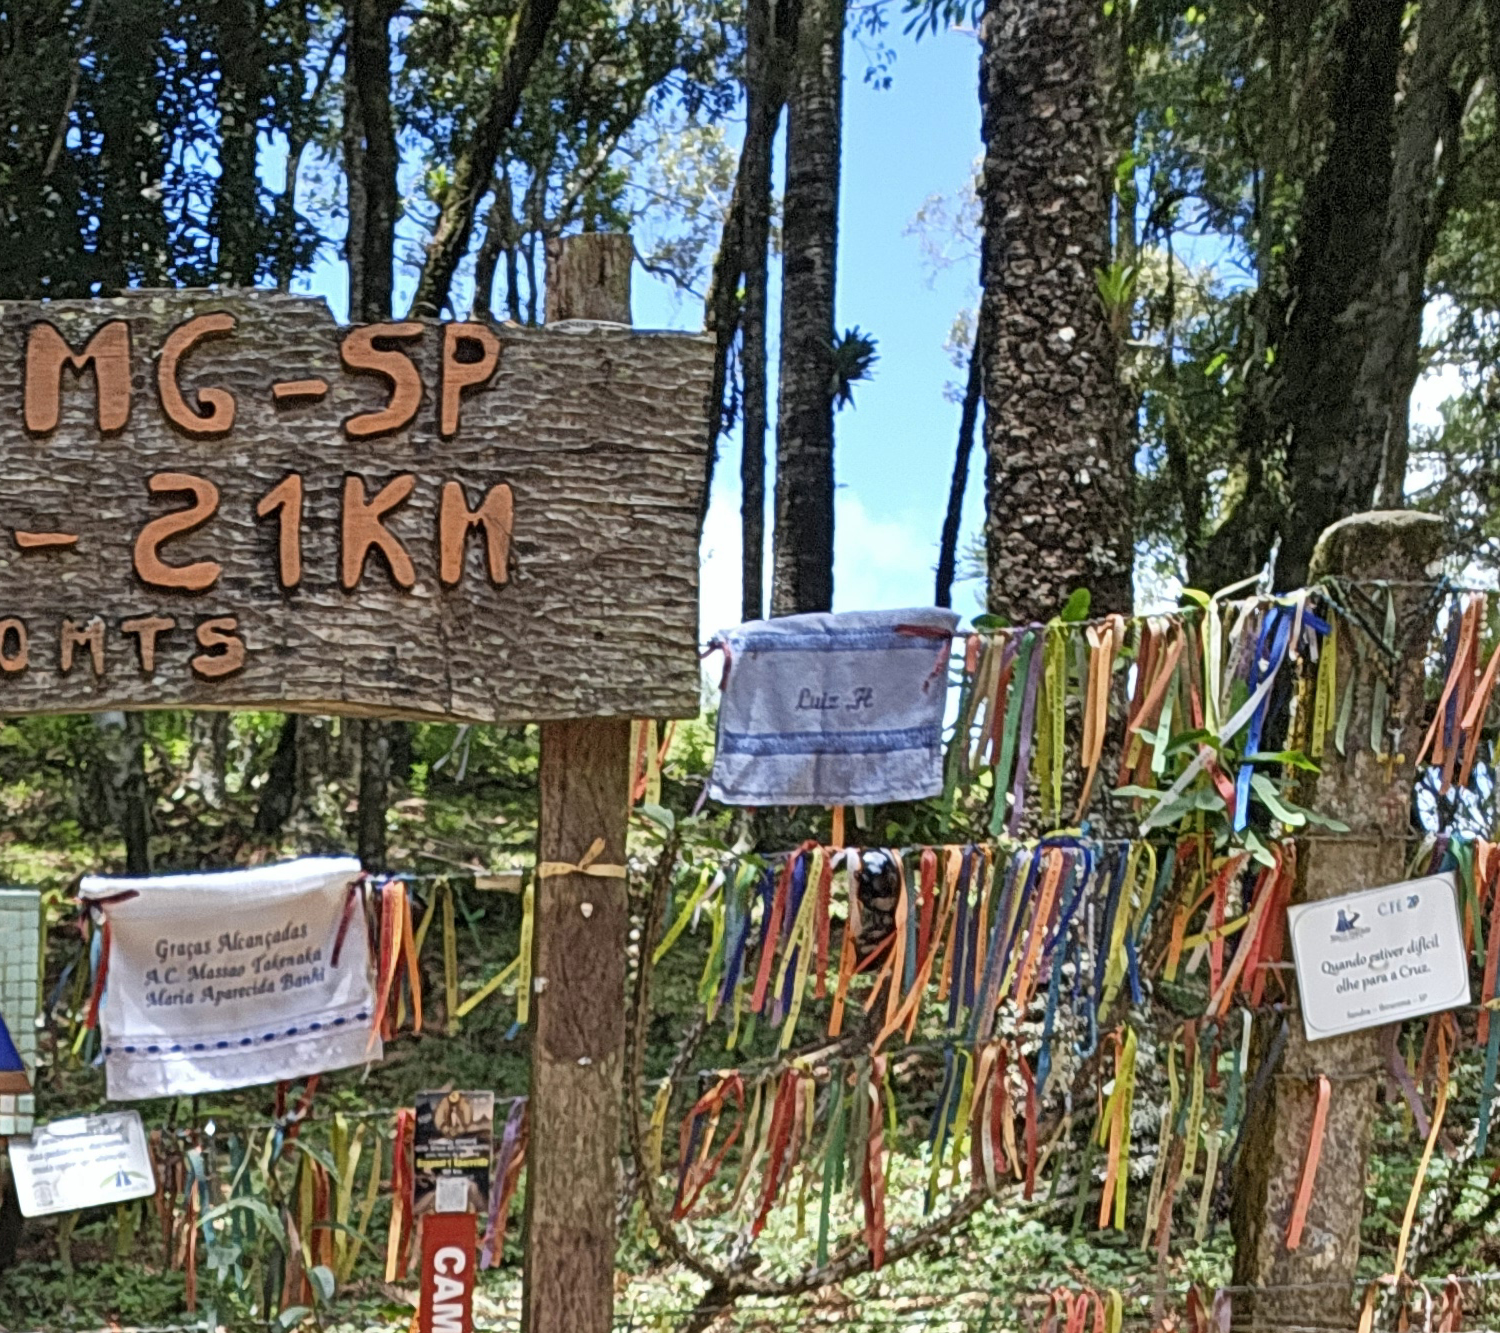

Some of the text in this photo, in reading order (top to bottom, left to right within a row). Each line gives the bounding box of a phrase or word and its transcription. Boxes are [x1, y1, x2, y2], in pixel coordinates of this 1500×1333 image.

[795, 687, 840, 711] Luiz
[155, 919, 308, 964] Graças Alcançadas
[187, 961, 246, 983] Massao
[251, 947, 322, 975] Takenaka
[1321, 952, 1367, 977] Quando
[1369, 943, 1405, 964] estiver
[145, 986, 194, 1008] Maria
[200, 977, 275, 1007] Aparecida
[1335, 970, 1360, 995] olhe
[1362, 974, 1388, 993] para
[1390, 972, 1398, 982] a
